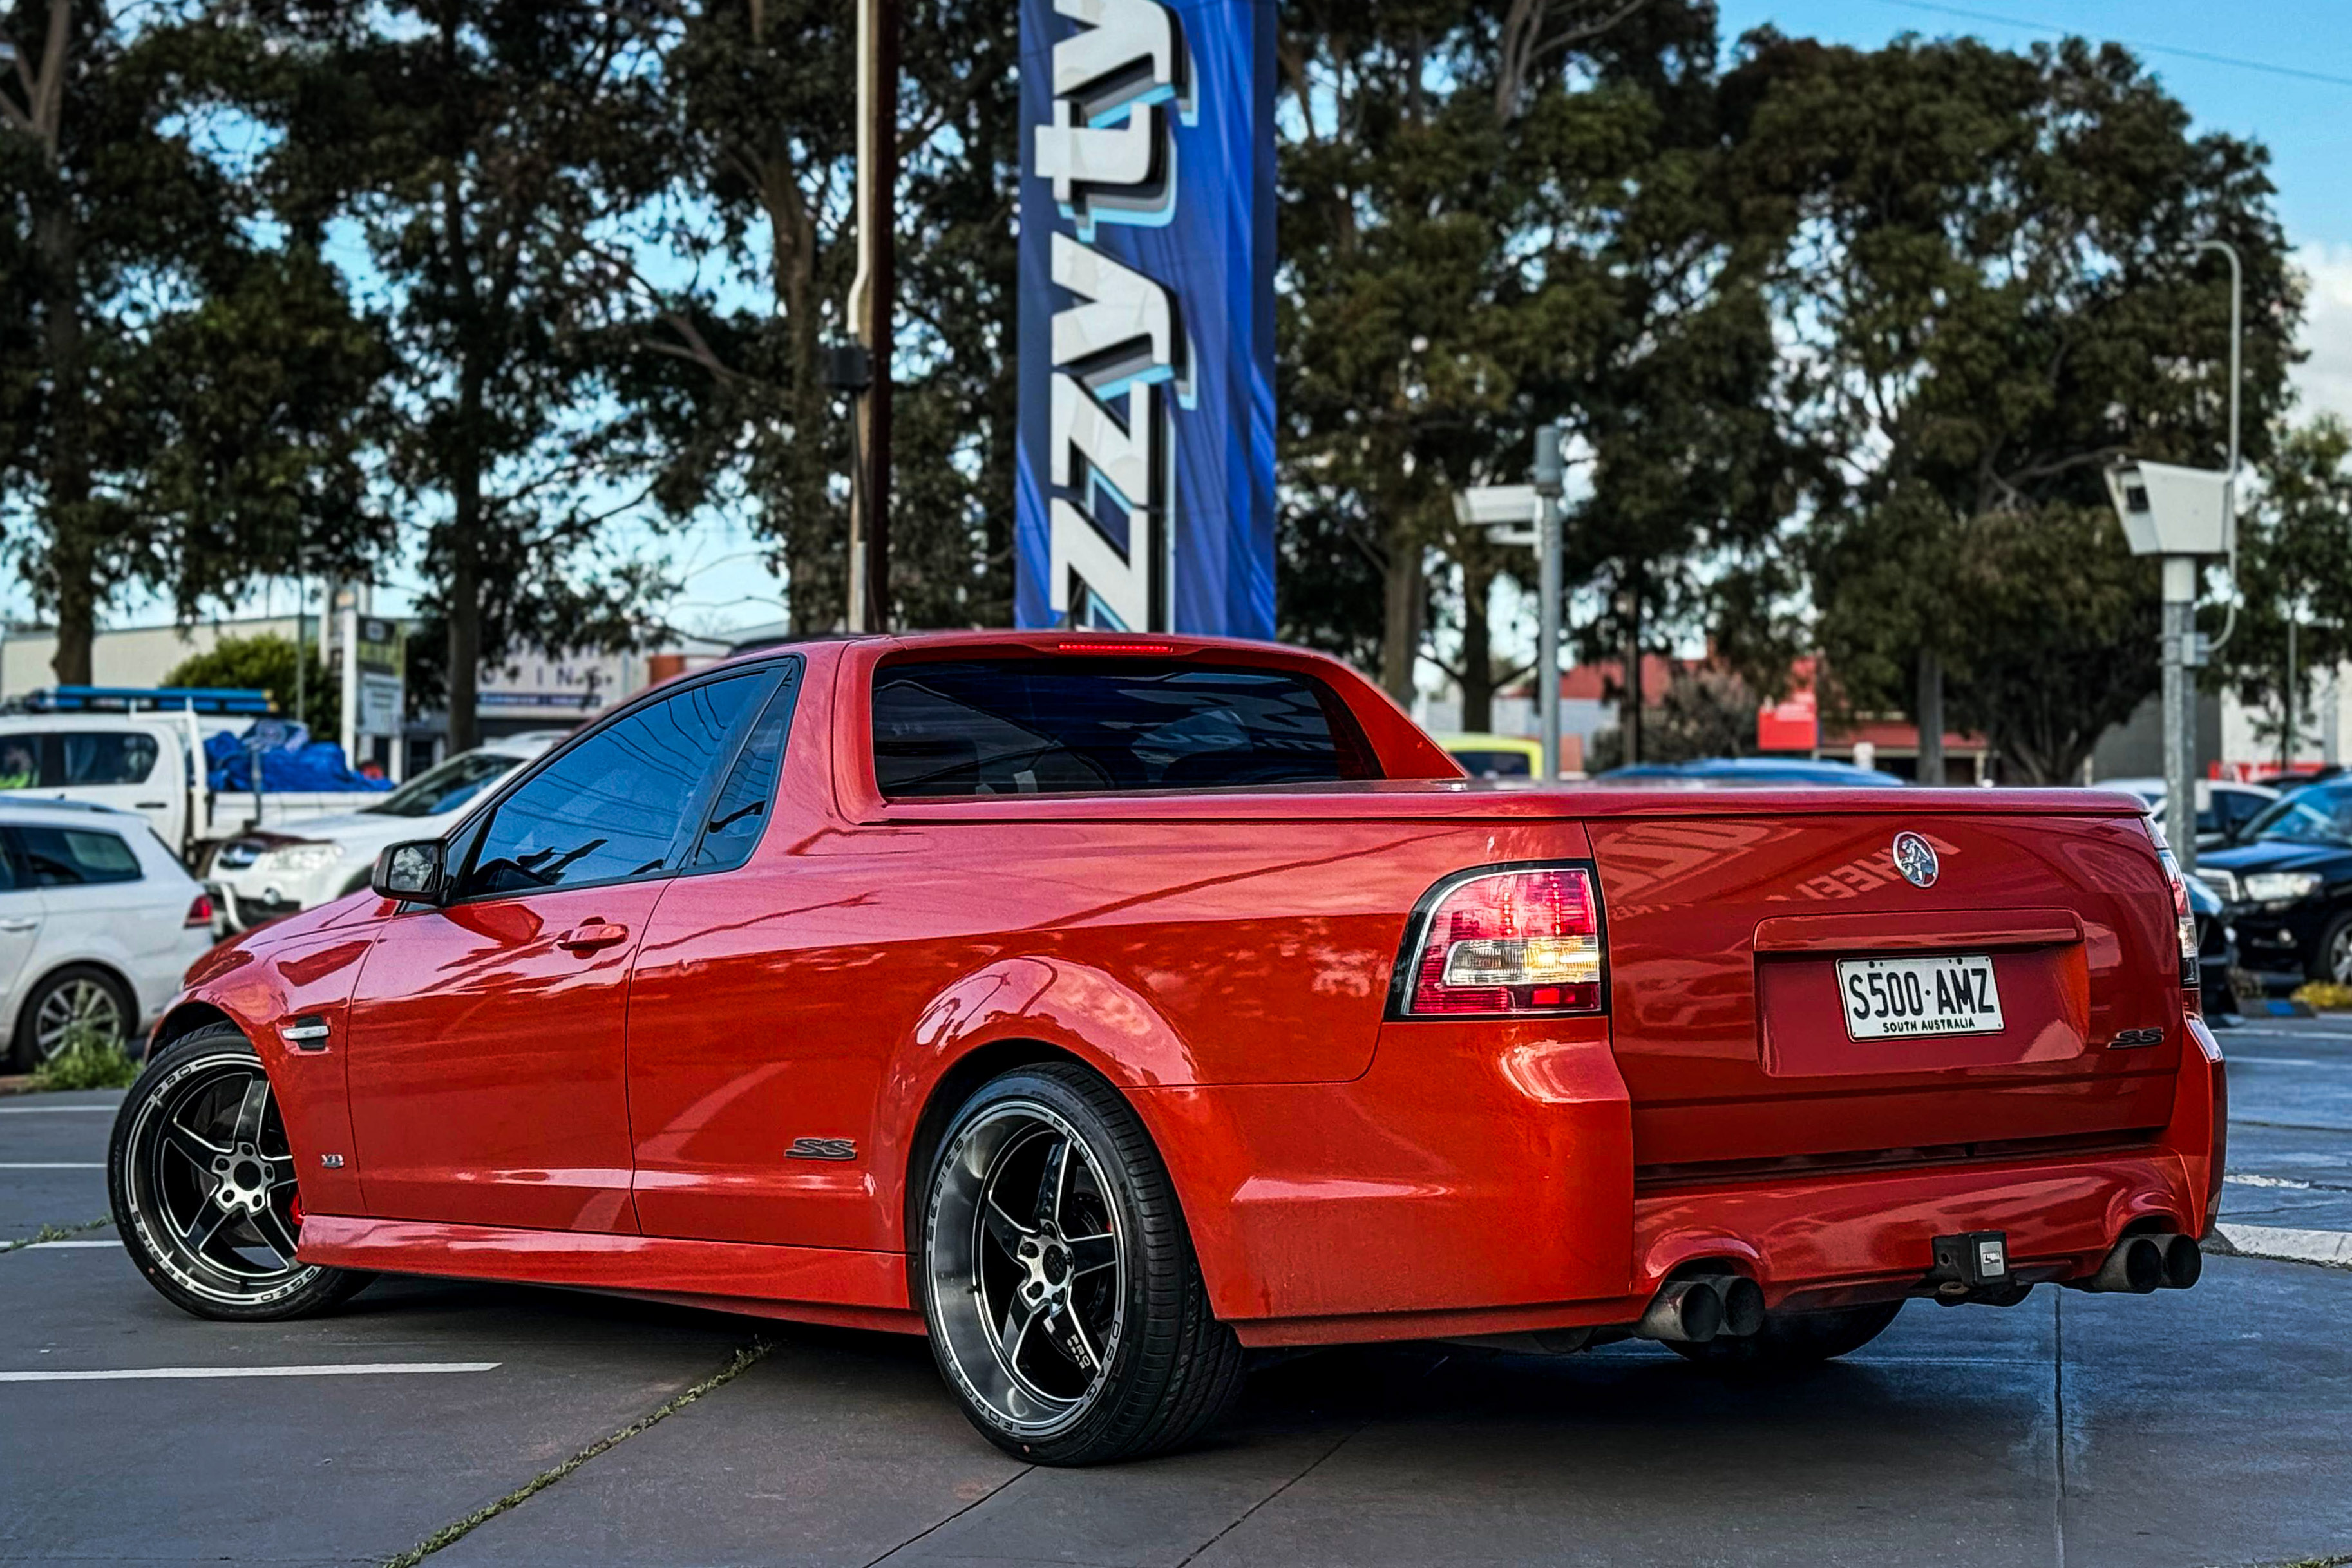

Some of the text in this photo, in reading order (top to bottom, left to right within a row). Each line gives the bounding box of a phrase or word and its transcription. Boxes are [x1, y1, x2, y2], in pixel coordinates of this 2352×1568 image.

[1883, 1017, 1976, 1033] SOUTH AUSTRALIA
[2105, 1026, 2165, 1049] SS
[153, 1065, 192, 1099] PRO
[783, 1137, 858, 1160] SS
[1052, 1116, 1091, 1161] PRO
[926, 1137, 965, 1243] SERIES
[1070, 1334, 1092, 1367] PRO
[1086, 1320, 1121, 1402] DRAG
[943, 1345, 1014, 1431] FORGED
